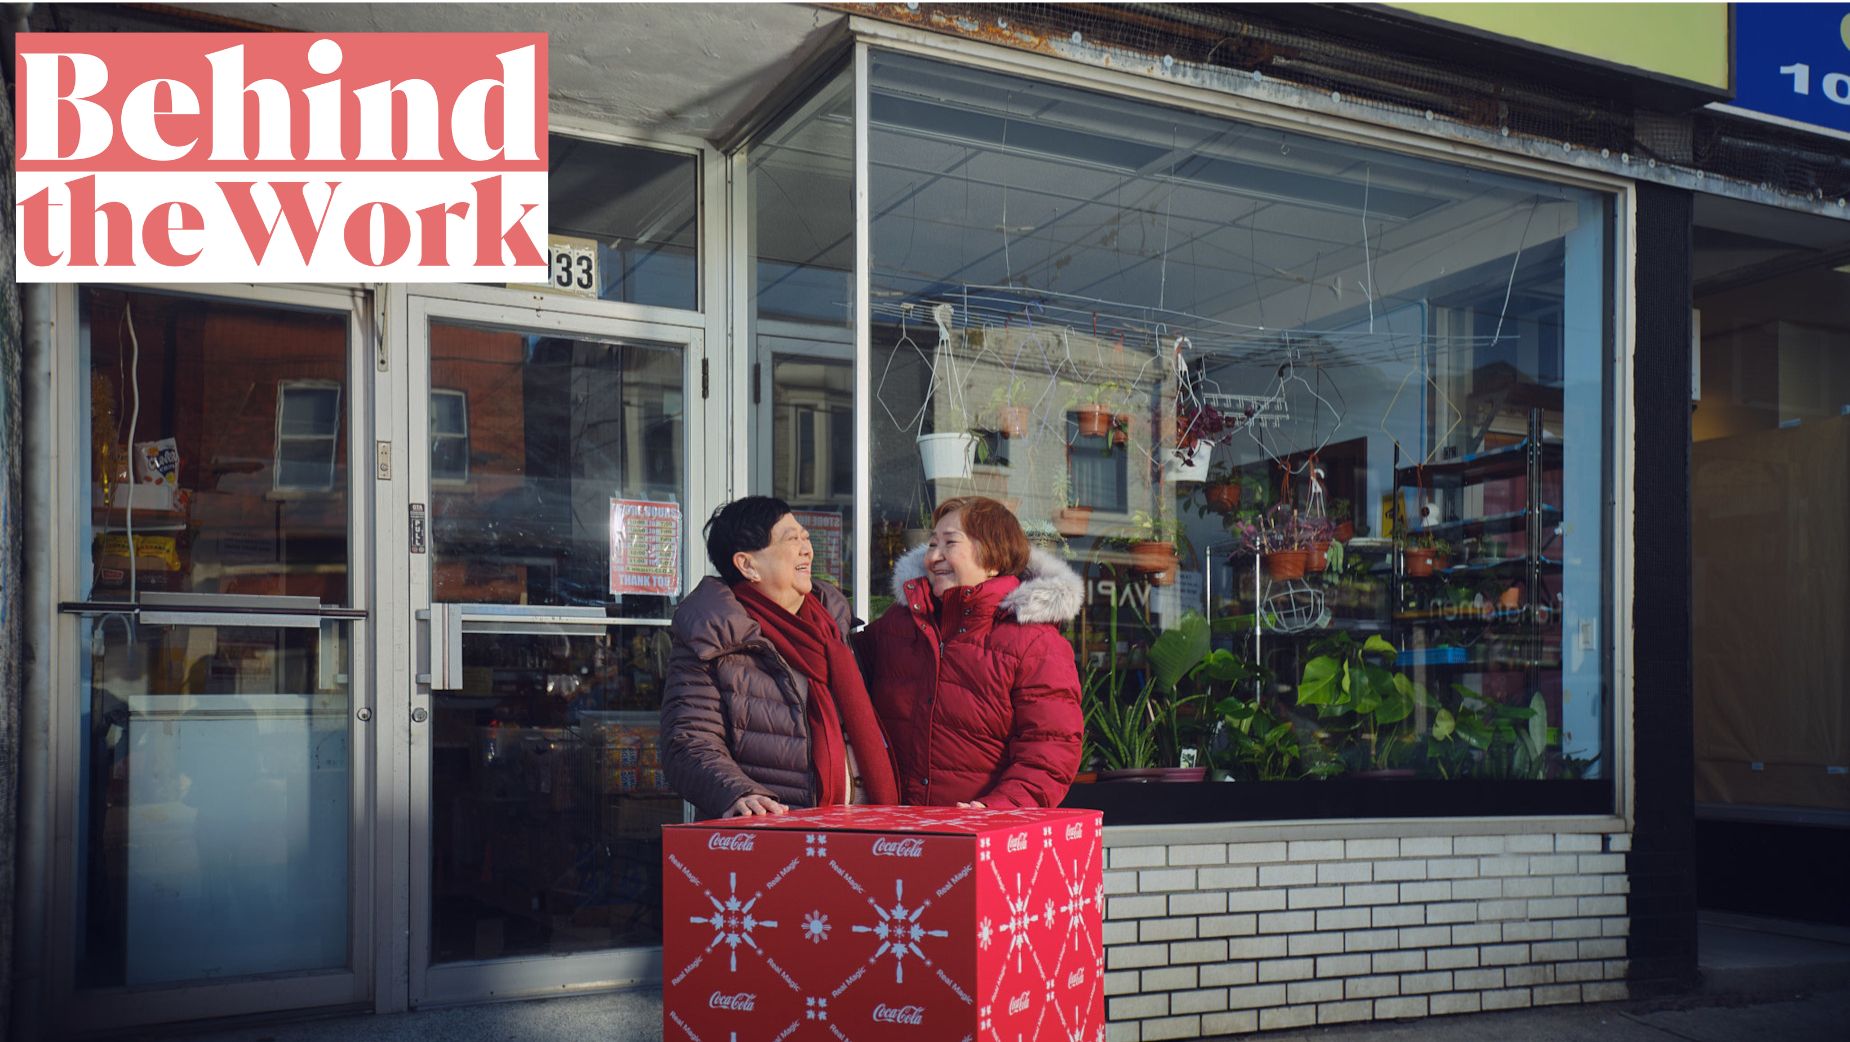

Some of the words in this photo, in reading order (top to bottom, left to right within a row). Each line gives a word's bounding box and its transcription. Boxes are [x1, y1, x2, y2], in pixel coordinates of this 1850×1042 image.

[548, 249, 593, 289] 33
[619, 573, 650, 586] THANK
[668, 853, 684, 870] Real
[829, 859, 844, 877] Real
[766, 874, 782, 890] Real
[935, 881, 952, 898] Real
[766, 957, 781, 974] Real
[671, 971, 687, 987] Real
[936, 968, 952, 986] Real
[831, 984, 847, 998] Real
